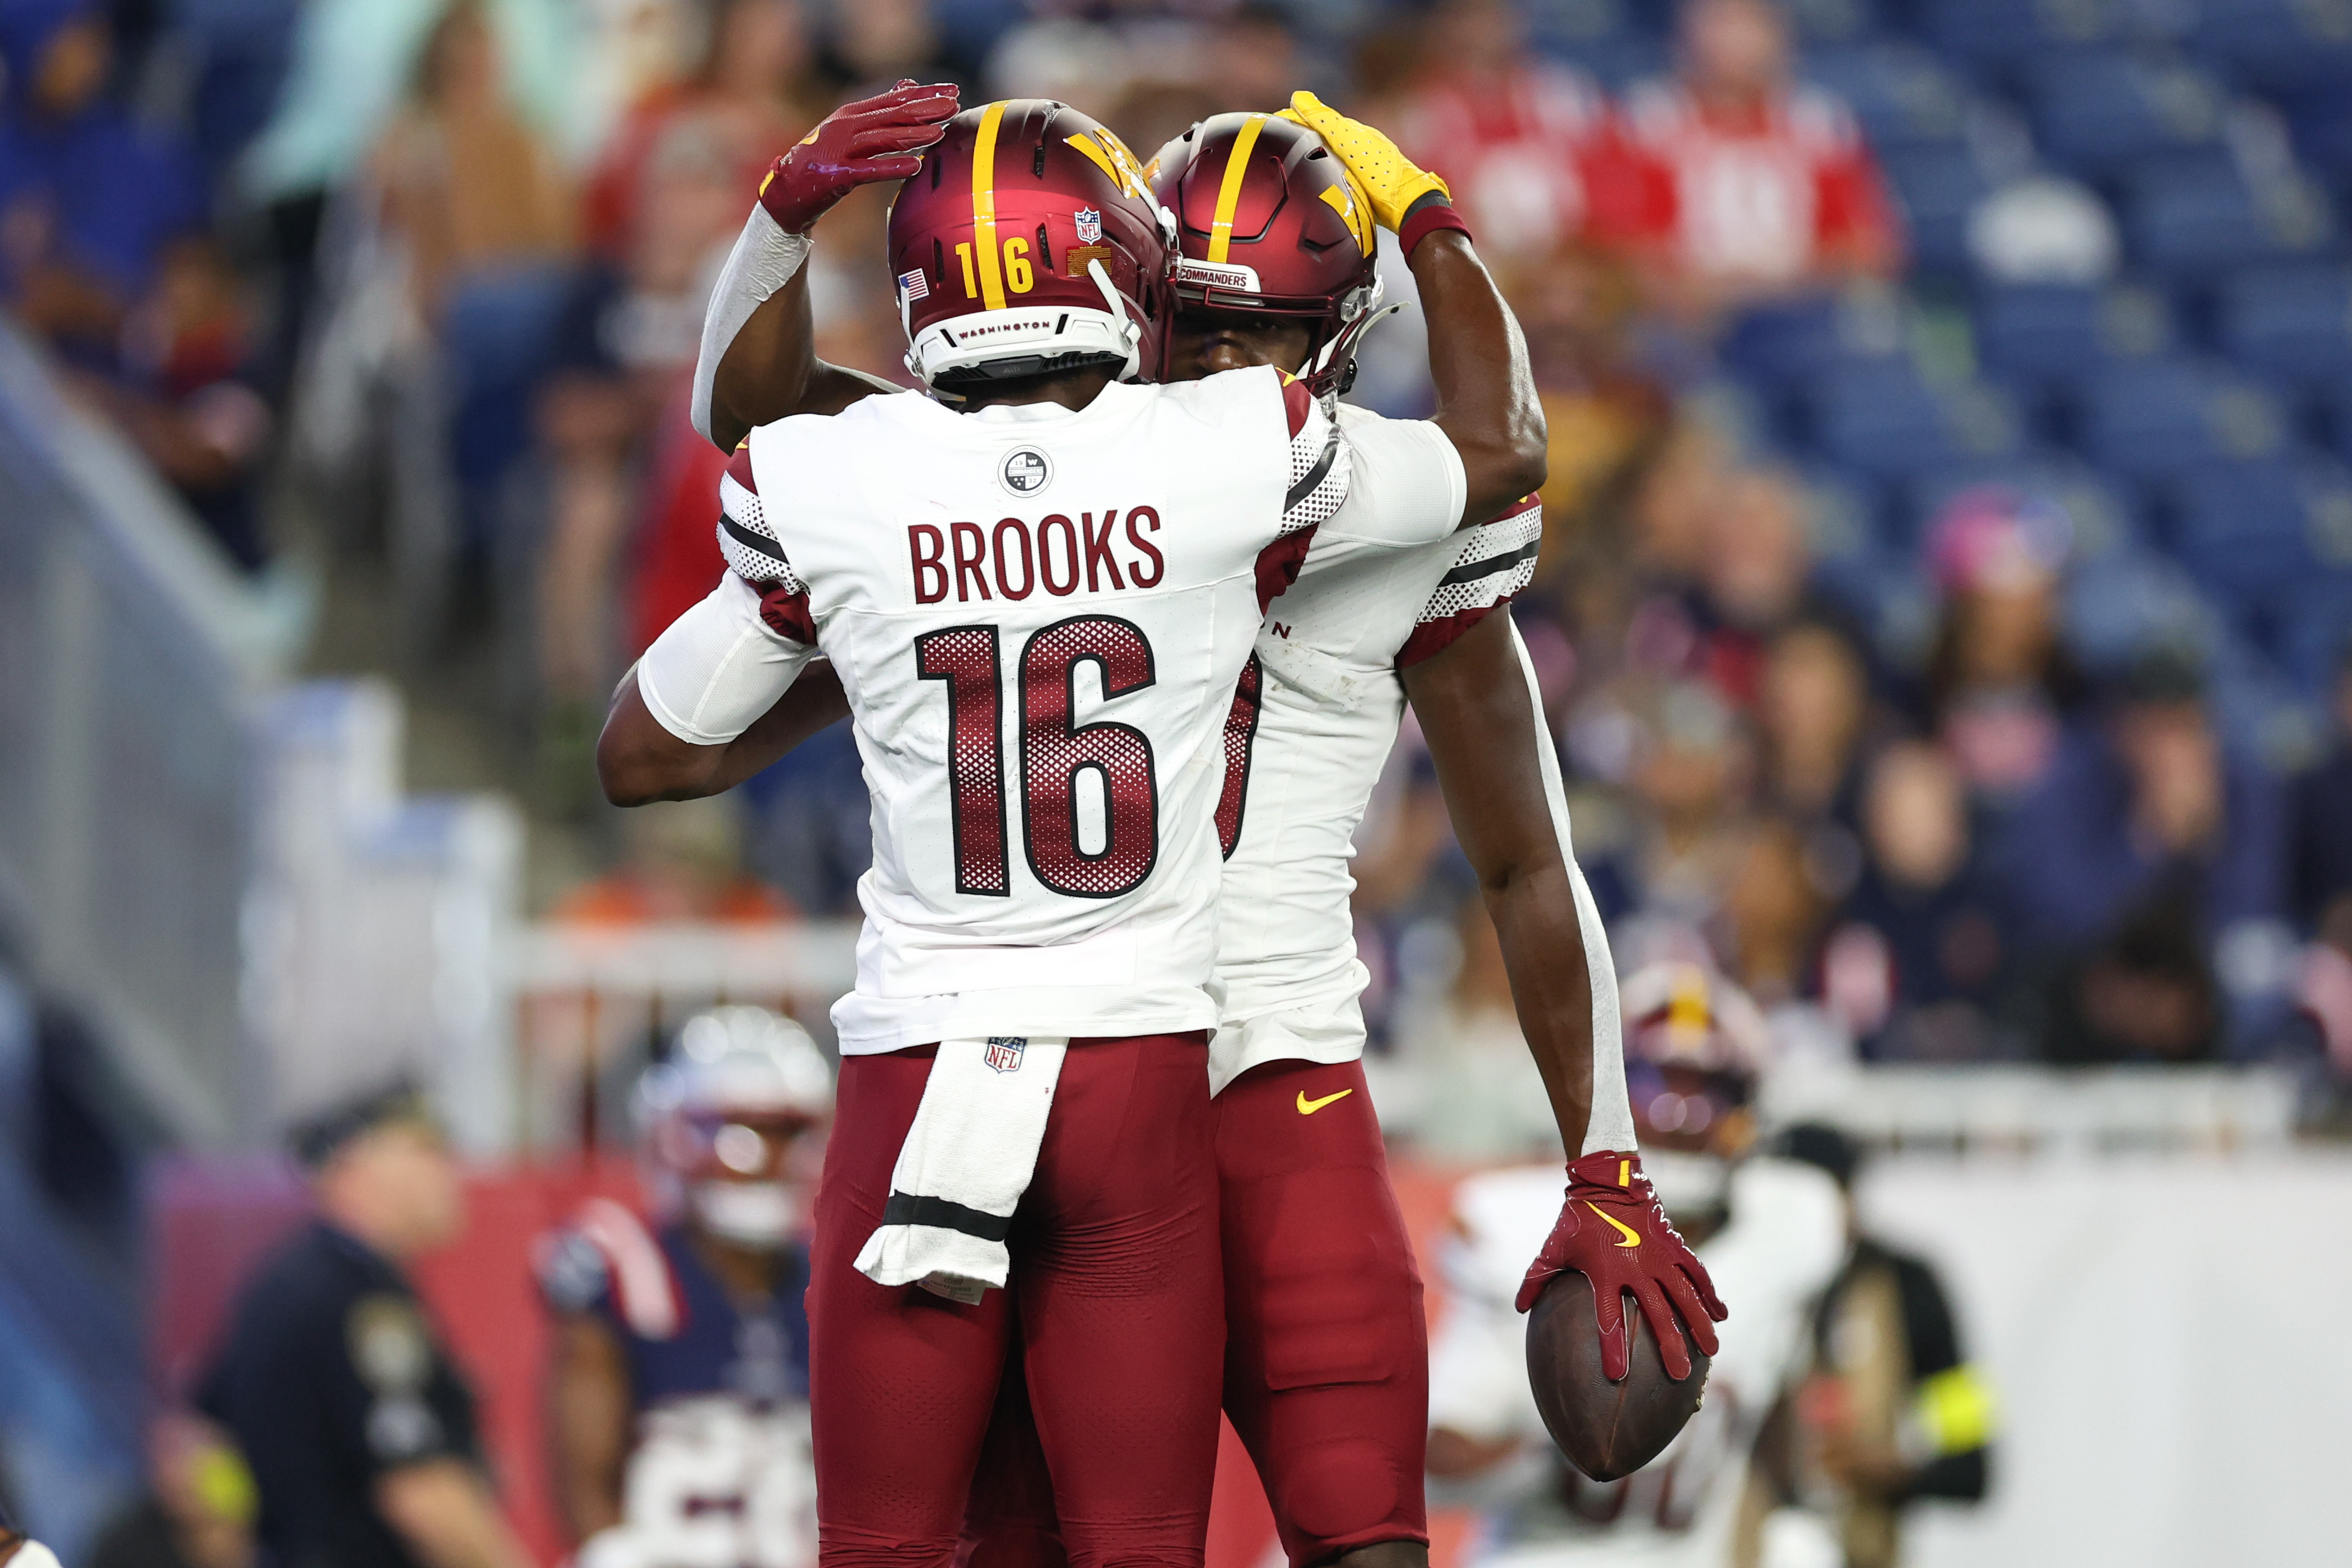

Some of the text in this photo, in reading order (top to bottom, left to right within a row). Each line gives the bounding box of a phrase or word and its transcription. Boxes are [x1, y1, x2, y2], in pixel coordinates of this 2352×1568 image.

[1079, 224, 1099, 238] NFL
[955, 237, 1034, 298] 16
[1180, 268, 1247, 287] COMMANDERS
[959, 321, 1050, 340] WASHINGTON
[908, 505, 1164, 604] BROOKS
[914, 614, 1159, 899] 16
[988, 1045, 1018, 1069] NFL
